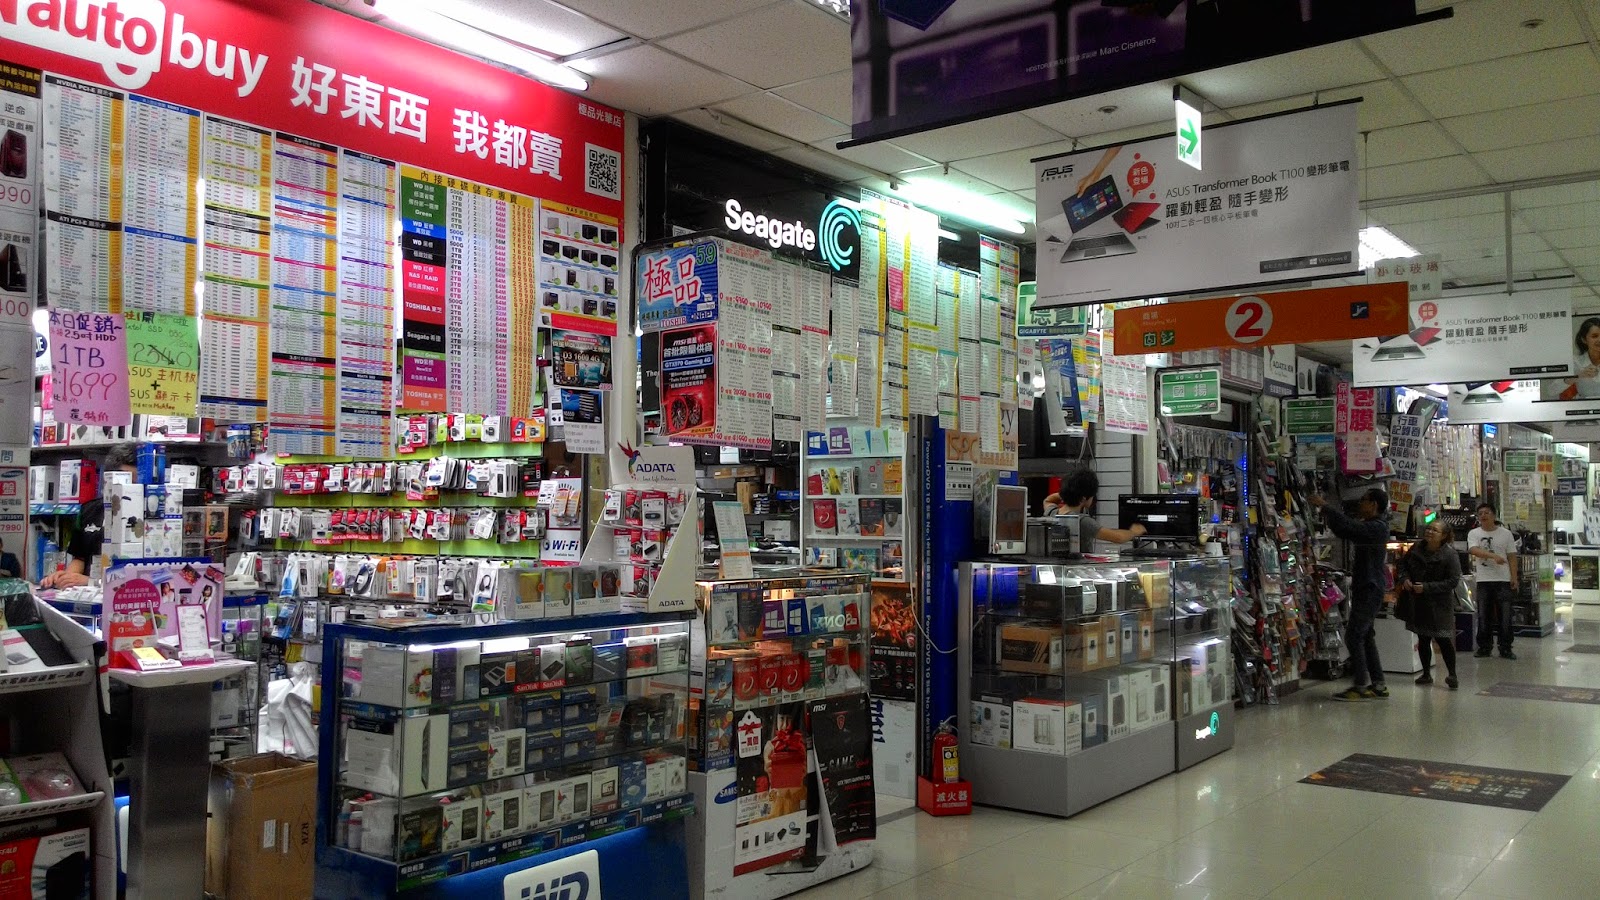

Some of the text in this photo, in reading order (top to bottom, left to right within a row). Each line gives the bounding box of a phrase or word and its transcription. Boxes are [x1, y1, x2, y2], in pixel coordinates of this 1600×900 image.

[1099, 37, 1157, 56] Marc Cisneros
[168, 14, 269, 97] buy
[290, 56, 563, 181] 好東西 我都賣
[578, 103, 622, 128] 極品光華店
[1041, 164, 1074, 178] ASUS
[1166, 160, 1351, 198] ASUS Transformer Book T100 變形筆電
[1165, 186, 1290, 219] 躍動輕盈 隨手變形
[724, 198, 816, 251] Seagate
[696, 245, 716, 265] 59
[643, 257, 699, 303] 極品
[0, 298, 29, 317] 00
[405, 302, 431, 312] TOSHIBA
[1234, 302, 1264, 338] 2
[1445, 318, 1463, 326] ASUS
[1463, 315, 1502, 325] Transformer
[1503, 314, 1520, 322] Book
[1522, 312, 1538, 320] T100
[95, 333, 117, 342] HDD
[407, 331, 430, 341] Seagate
[1445, 323, 1528, 339] 躍動輕盈 隨手變形
[59, 343, 105, 368] 1TB
[128, 366, 152, 378] SUS
[63, 368, 117, 400] 1699
[406, 391, 432, 399] TOSHIBA
[636, 463, 676, 473] ADATA
[1398, 460, 1418, 471] CAM
[552, 540, 579, 551] Wi-Fi
[516, 683, 539, 692] SanDisk
[542, 679, 565, 688] SanDisk
[813, 703, 827, 712] msi
[719, 787, 737, 797] SAMS
[936, 790, 968, 802] 滅火器
